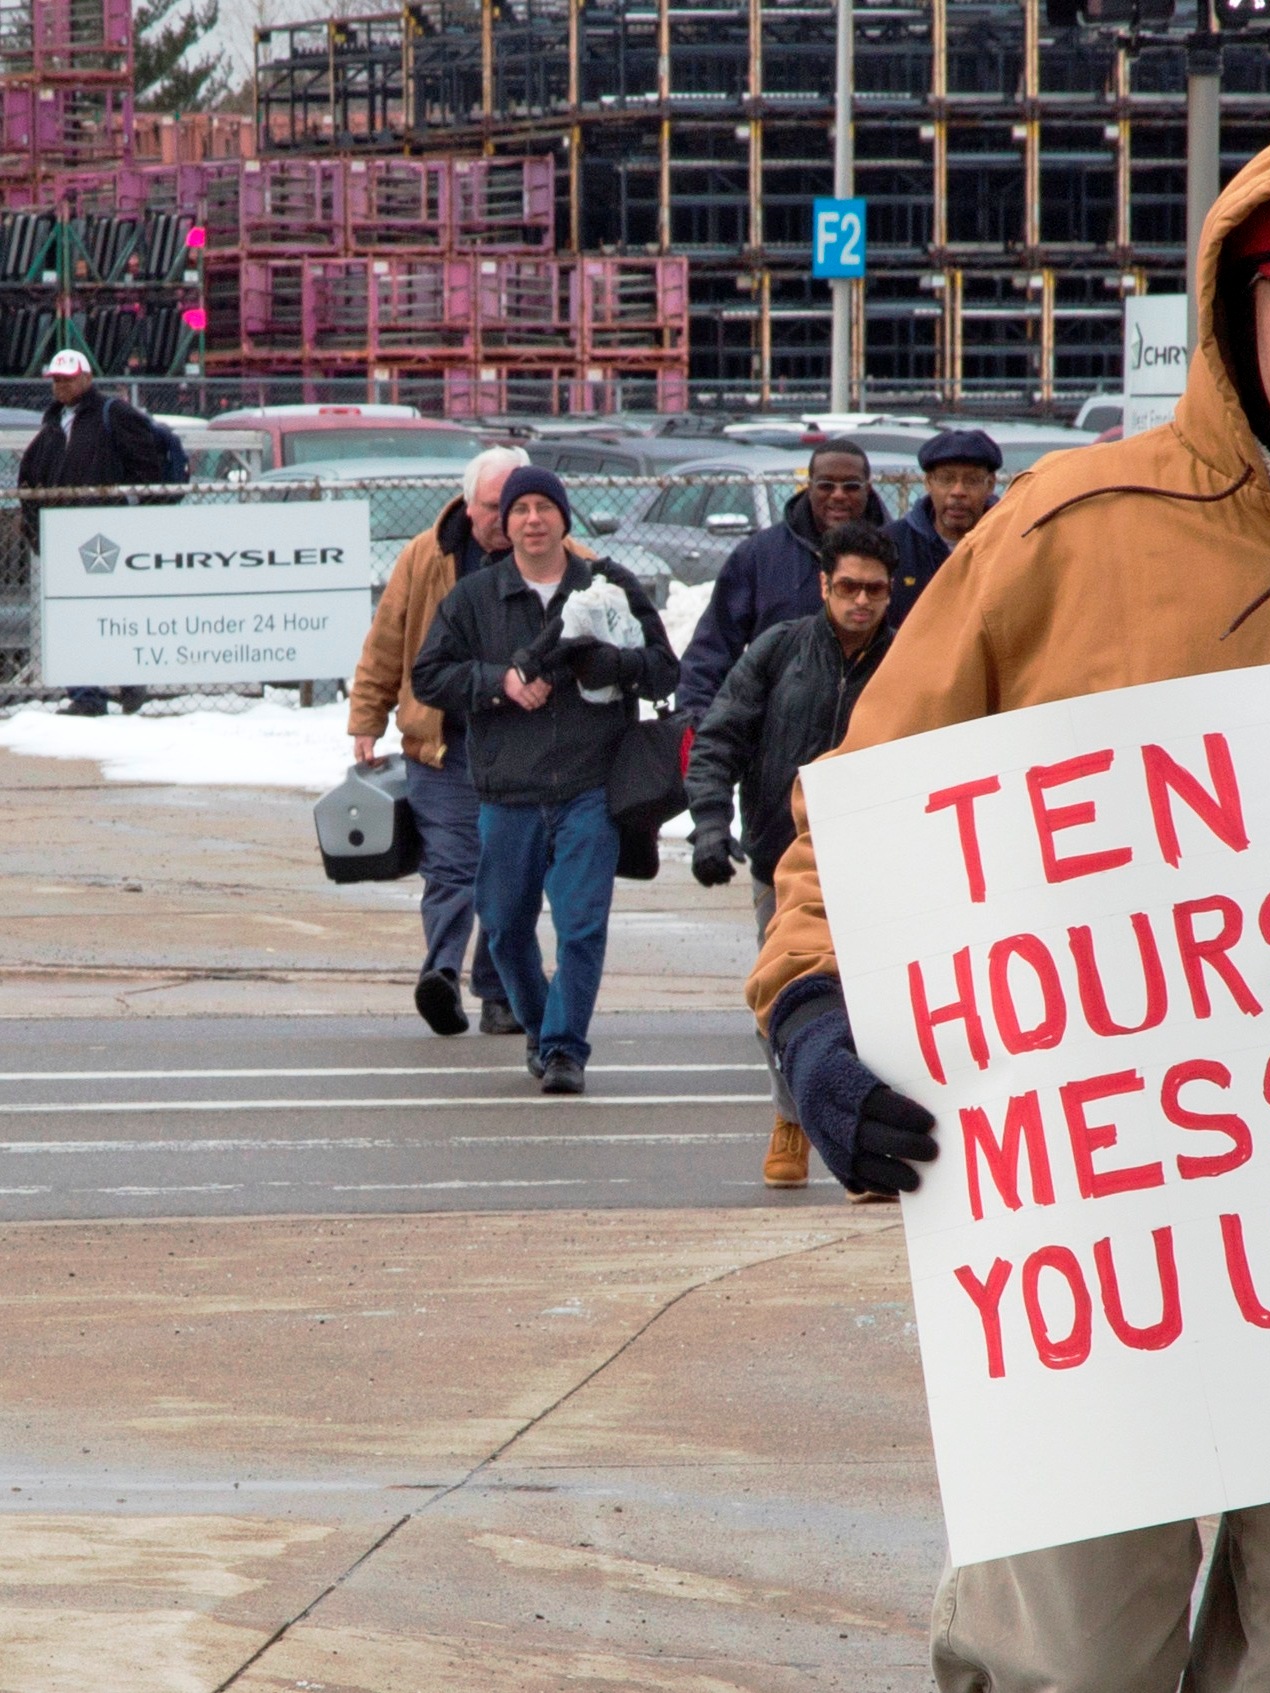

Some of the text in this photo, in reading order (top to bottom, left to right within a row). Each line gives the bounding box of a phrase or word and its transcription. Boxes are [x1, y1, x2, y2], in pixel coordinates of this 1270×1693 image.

[817, 212, 861, 266] F2
[124, 548, 345, 571] CHRYSLER
[97, 612, 329, 637] This Lot Under 24 Hour
[133, 643, 297, 666] T.V. Surveillance
[925, 732, 1249, 903] TEN
[954, 1226, 1183, 1378] YOU
